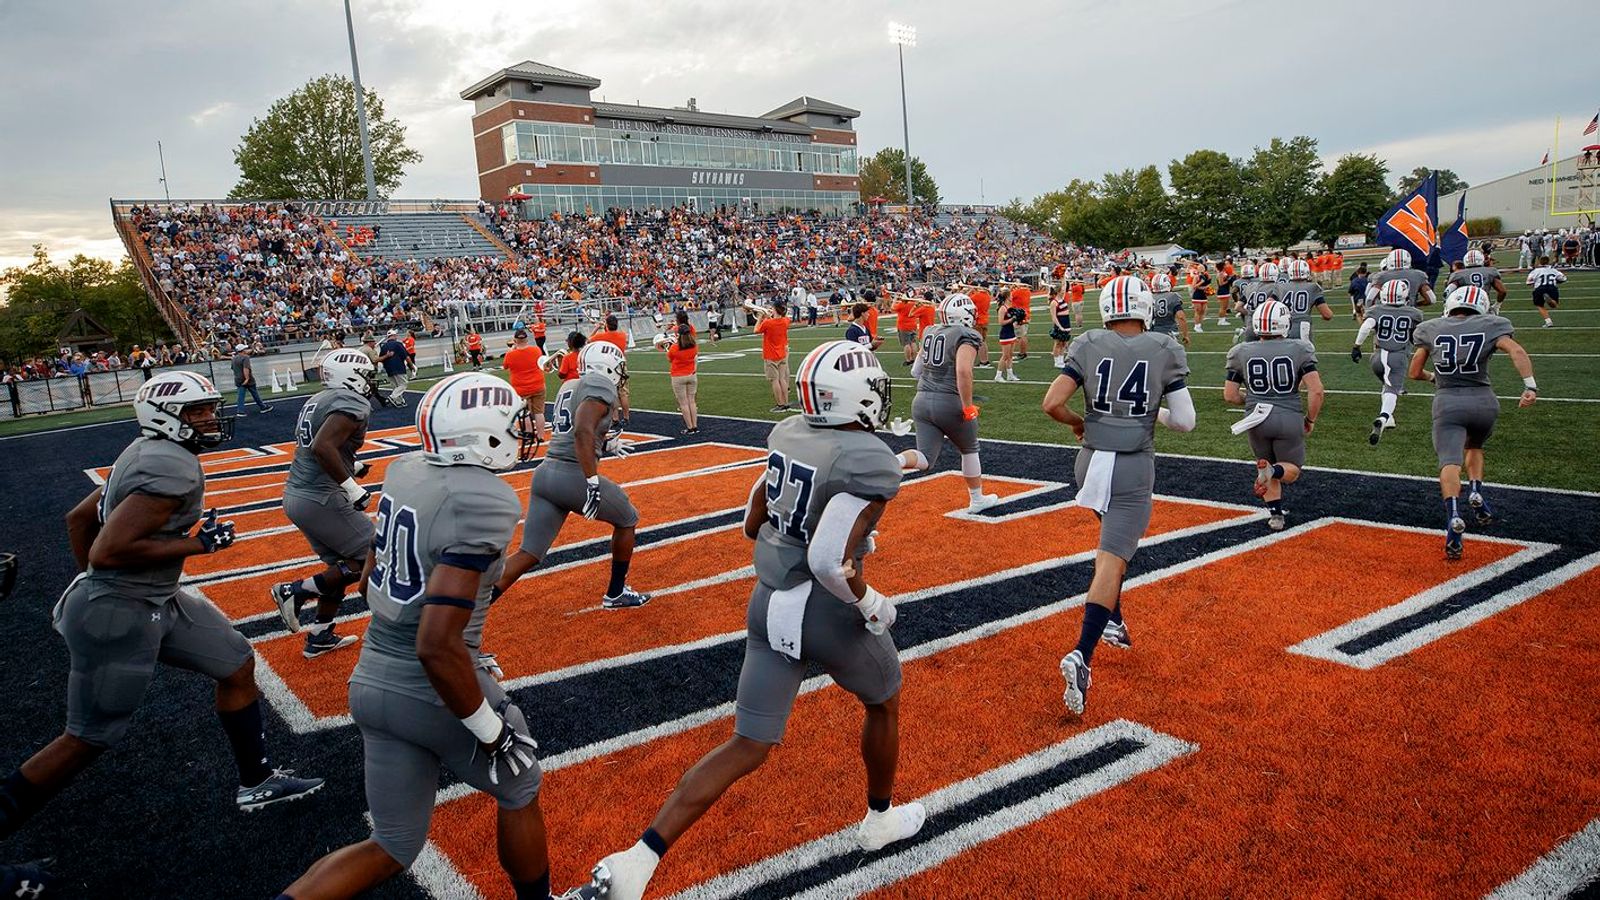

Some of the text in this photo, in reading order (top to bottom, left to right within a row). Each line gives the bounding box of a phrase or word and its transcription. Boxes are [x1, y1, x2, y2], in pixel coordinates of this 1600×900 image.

[610, 119, 631, 130] THE
[633, 122, 692, 135] UNIVERSITY
[694, 126, 709, 136] OF
[710, 128, 757, 140] TENNESSEE
[772, 134, 802, 144] MARTIN
[691, 171, 745, 186] SKYHAWKS
[1528, 178, 1545, 186] NED
[1470, 272, 1484, 289] 9
[1538, 273, 1557, 287] 16
[1281, 290, 1310, 314] 40
[1376, 315, 1412, 344] 89
[338, 353, 369, 365] UTM
[839, 350, 879, 373] UTM
[923, 333, 946, 367] 90
[1433, 333, 1486, 375] 37
[1091, 357, 1150, 416] 14
[1246, 355, 1295, 395] 80
[460, 386, 514, 410] UTM
[822, 402, 833, 412] 27
[452, 453, 465, 462] 20
[765, 448, 818, 545] 27
[367, 492, 426, 605] 20
